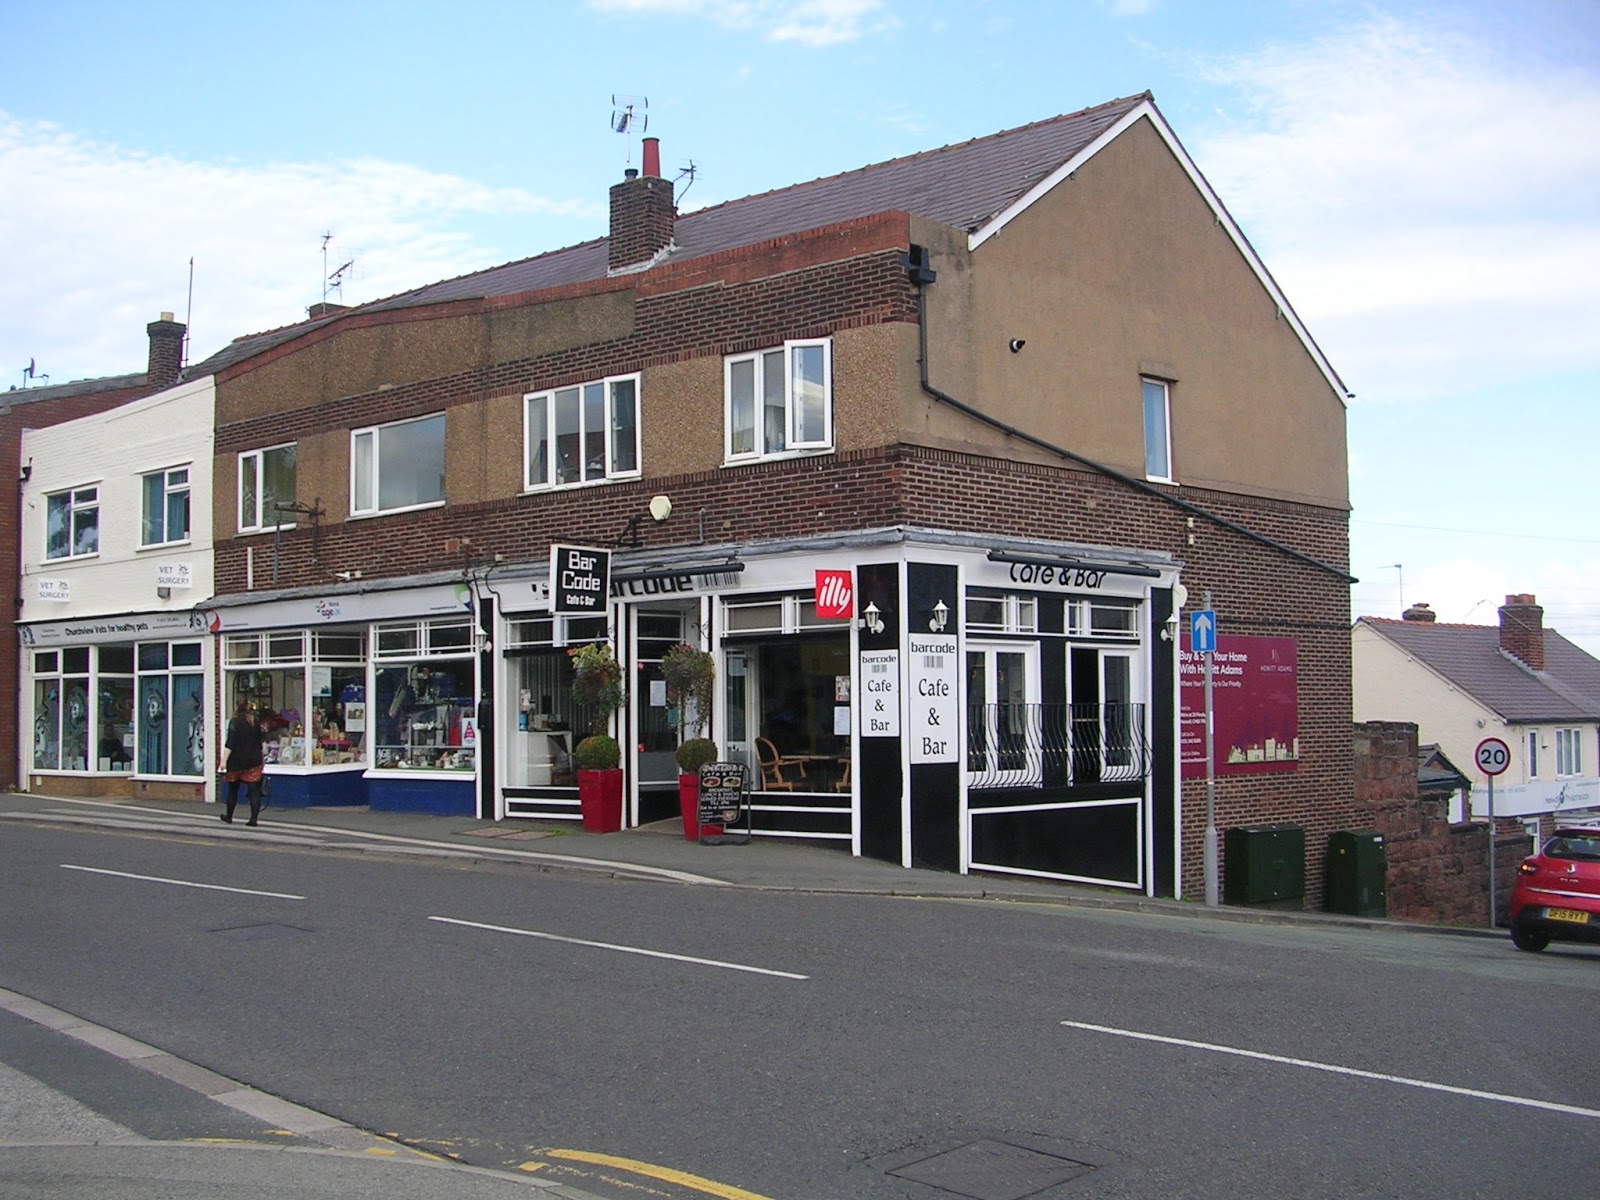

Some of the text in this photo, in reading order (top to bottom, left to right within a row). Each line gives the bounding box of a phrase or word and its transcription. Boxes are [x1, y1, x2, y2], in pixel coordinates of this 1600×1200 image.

[568, 551, 597, 570] Bar
[159, 566, 173, 574] VET
[1010, 562, 1106, 589] Cafe & Bar
[158, 576, 190, 585] SURGERY
[562, 570, 601, 591] Code
[38, 591, 69, 599] SURGERY
[566, 594, 580, 605] Cafe
[585, 595, 596, 606] Bar
[819, 575, 851, 615] illy
[95, 624, 107, 634] Vets
[116, 622, 136, 633] healthy
[136, 622, 149, 632] pets
[911, 642, 956, 653] barcode
[862, 655, 897, 664] barcode
[1180, 650, 1192, 664] Buy
[1213, 651, 1228, 662] Your
[1229, 651, 1248, 662] Home
[1180, 664, 1197, 674] With
[1221, 664, 1243, 675] Adams
[867, 680, 892, 692] Cafe
[918, 678, 949, 697] Cafe
[875, 699, 885, 712] &
[927, 707, 941, 726] &
[870, 719, 890, 731] Bar
[922, 737, 947, 755] Bar
[1481, 749, 1506, 765] 20
